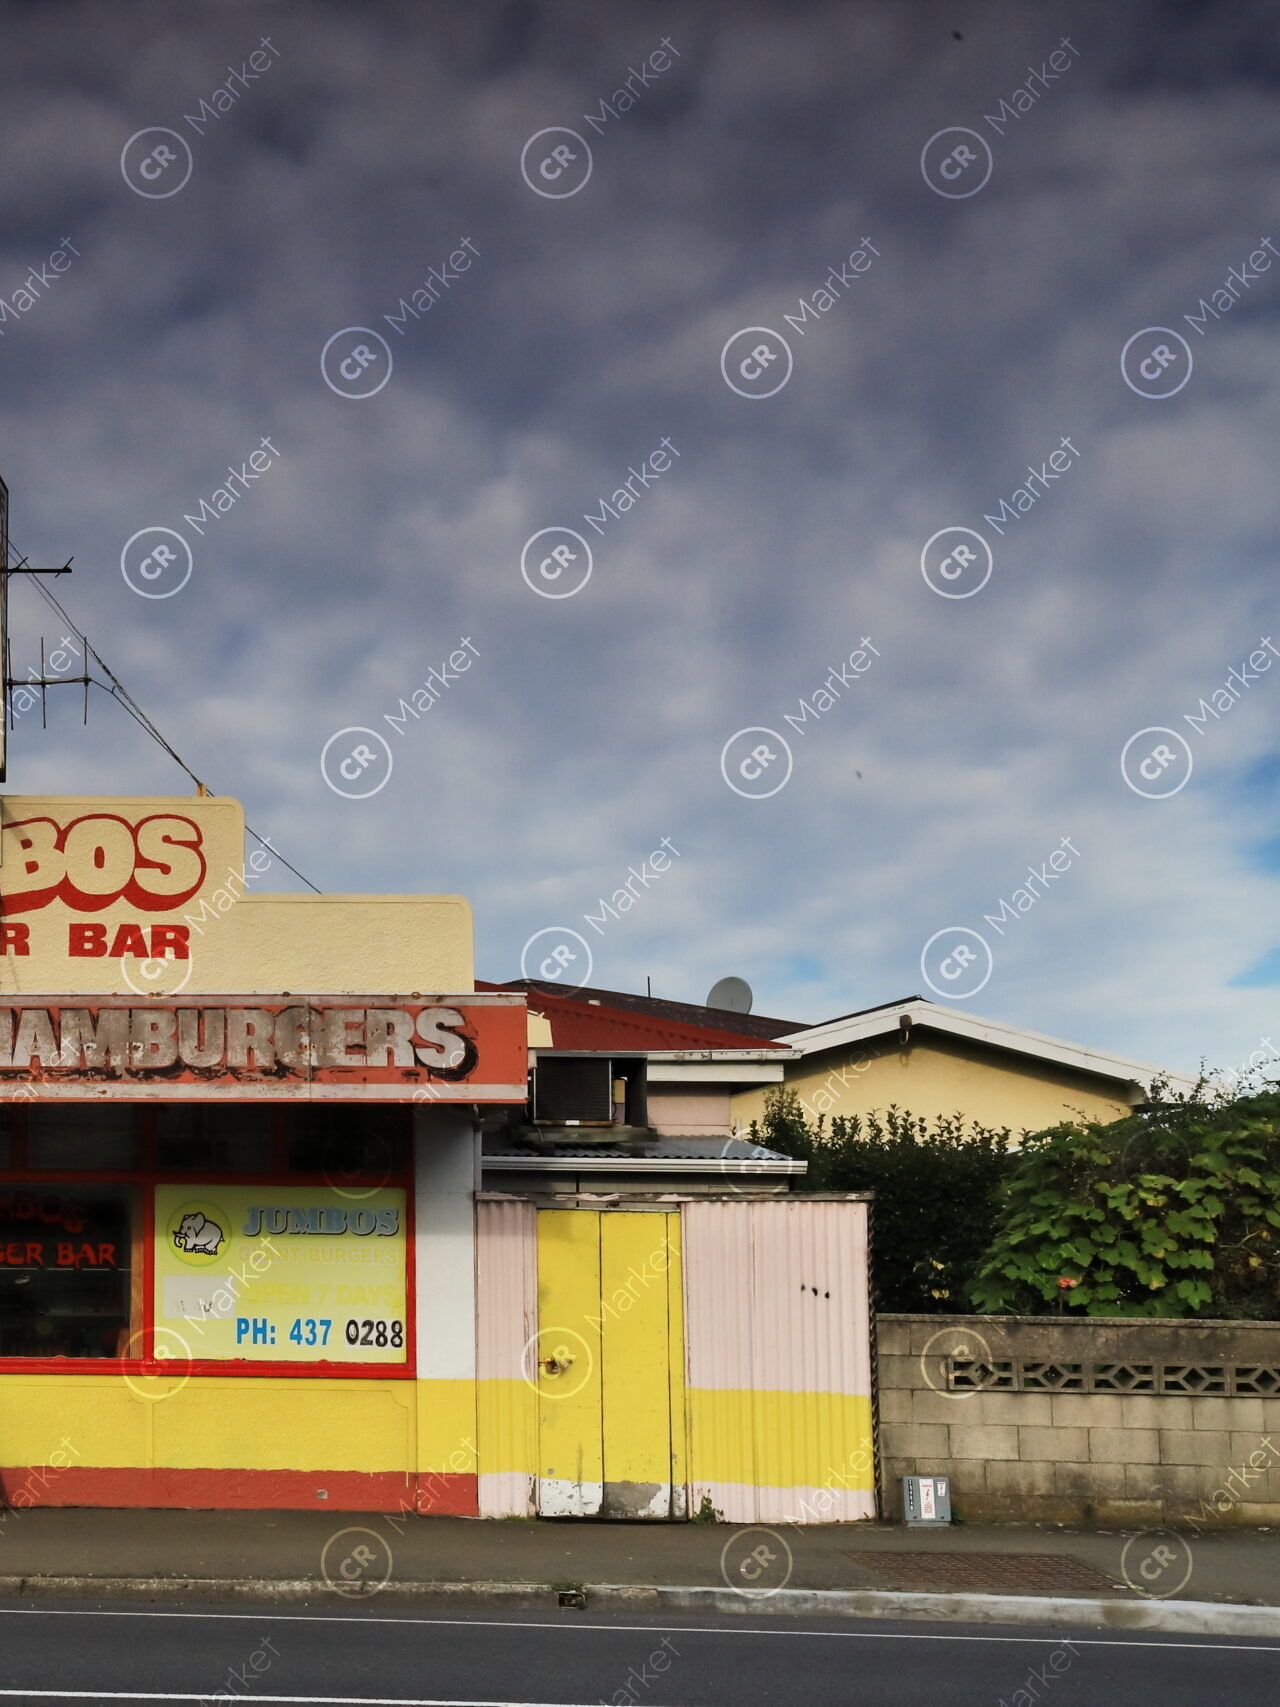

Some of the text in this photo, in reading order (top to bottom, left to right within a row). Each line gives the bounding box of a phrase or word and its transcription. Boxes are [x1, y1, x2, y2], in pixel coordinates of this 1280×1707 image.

[68, 923, 190, 960] BAR
[242, 1206, 400, 1237] JUMBOS
[56, 1242, 117, 1269] BAR
[307, 1246, 400, 1265] BURGERS
[236, 1317, 404, 1348] PH: 437 0288
